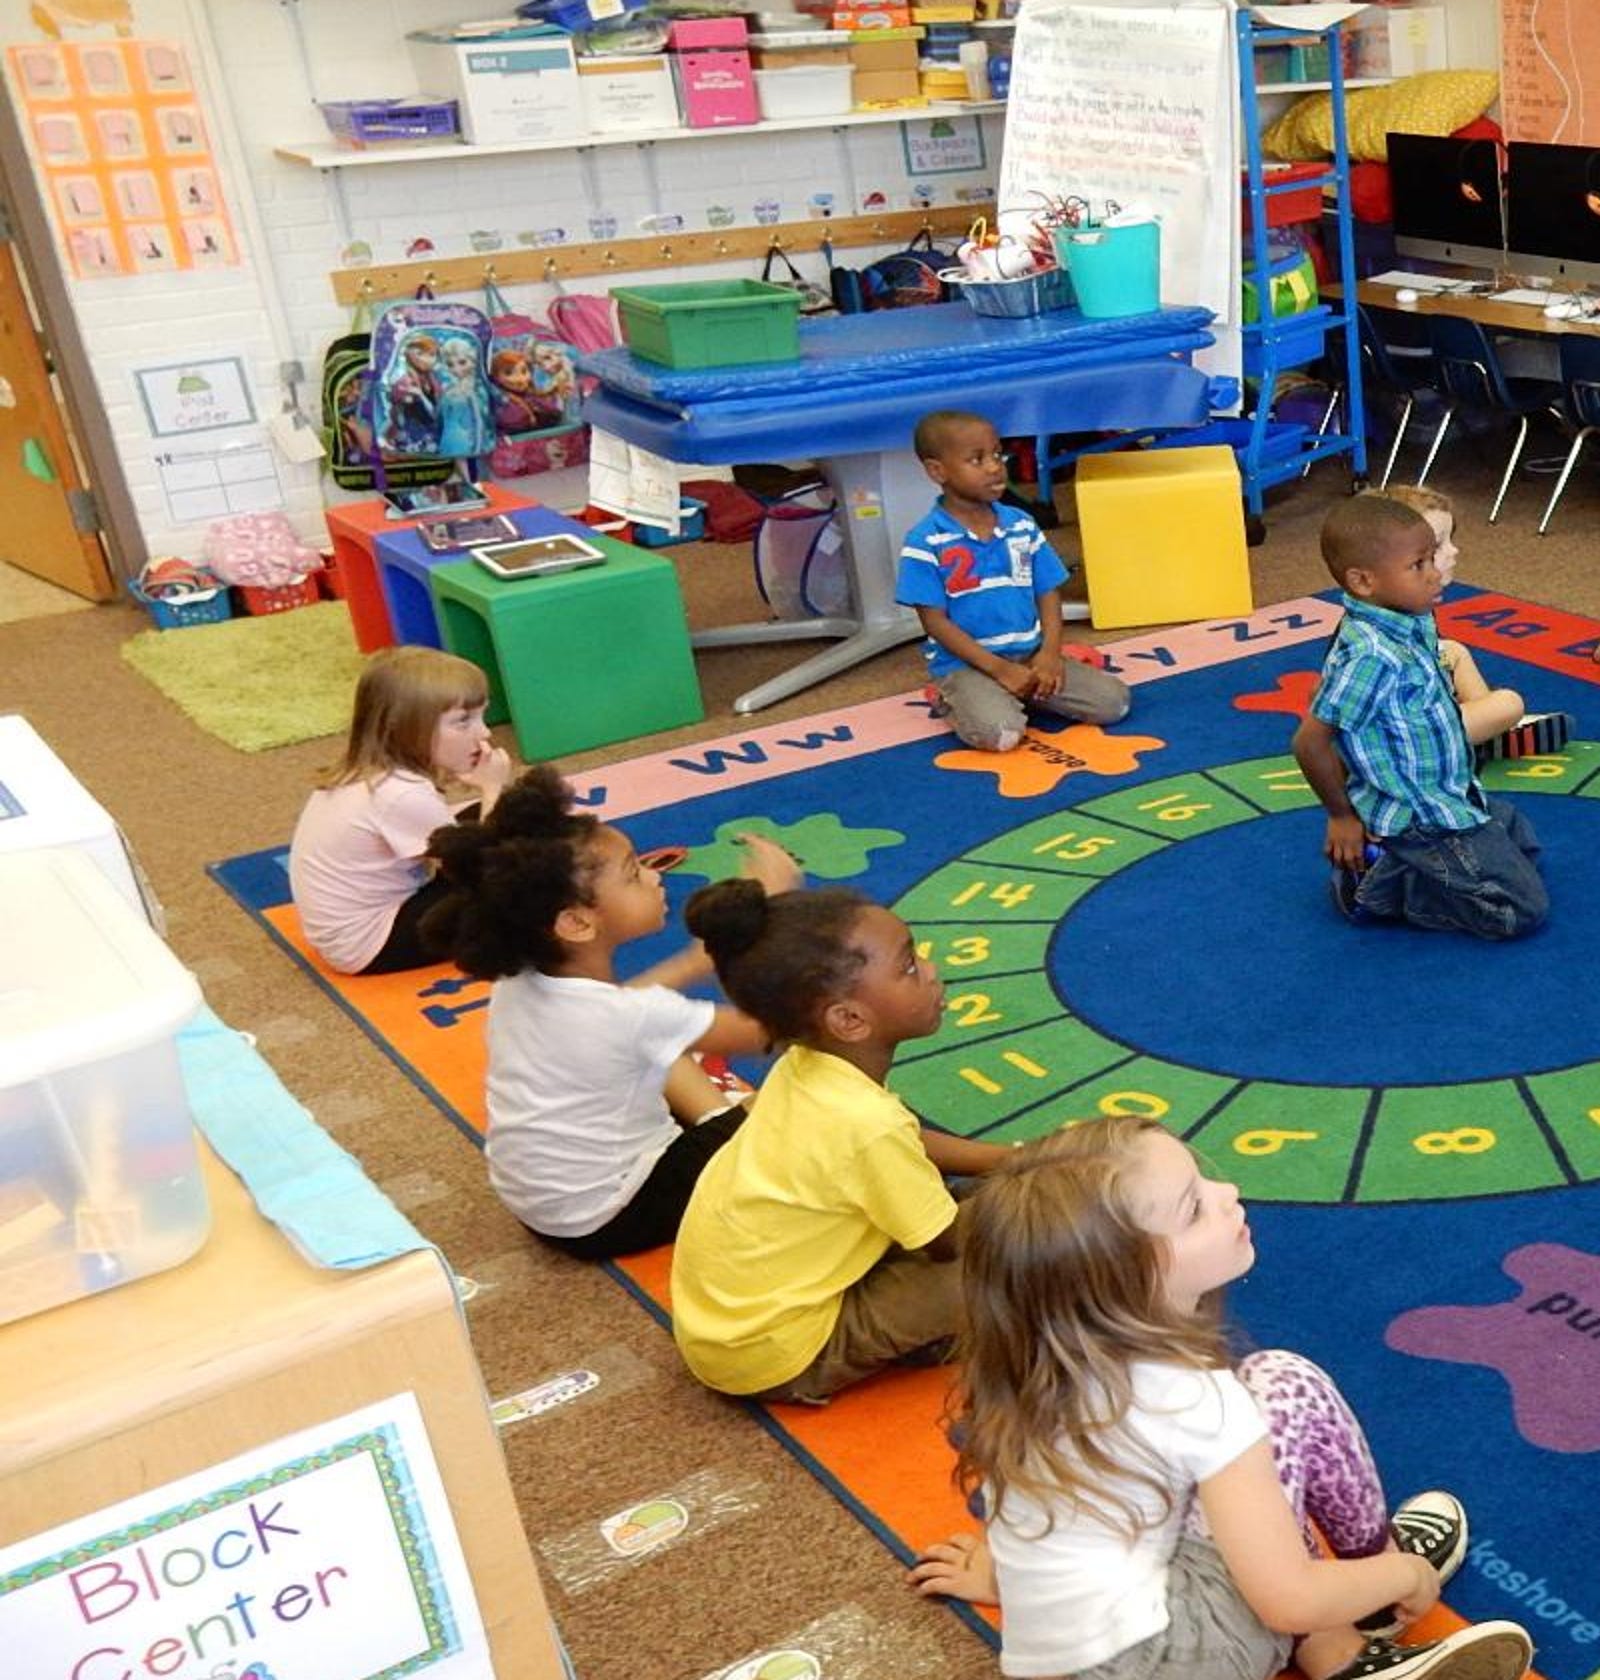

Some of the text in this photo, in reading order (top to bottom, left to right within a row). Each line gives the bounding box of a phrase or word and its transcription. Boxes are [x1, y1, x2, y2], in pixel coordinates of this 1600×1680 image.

[941, 545, 981, 596] 2
[1138, 792, 1213, 822] 16
[1033, 832, 1116, 860] 15
[950, 881, 1036, 909] 14
[1413, 1127, 1497, 1156] 8
[71, 1566, 348, 1680] Center
